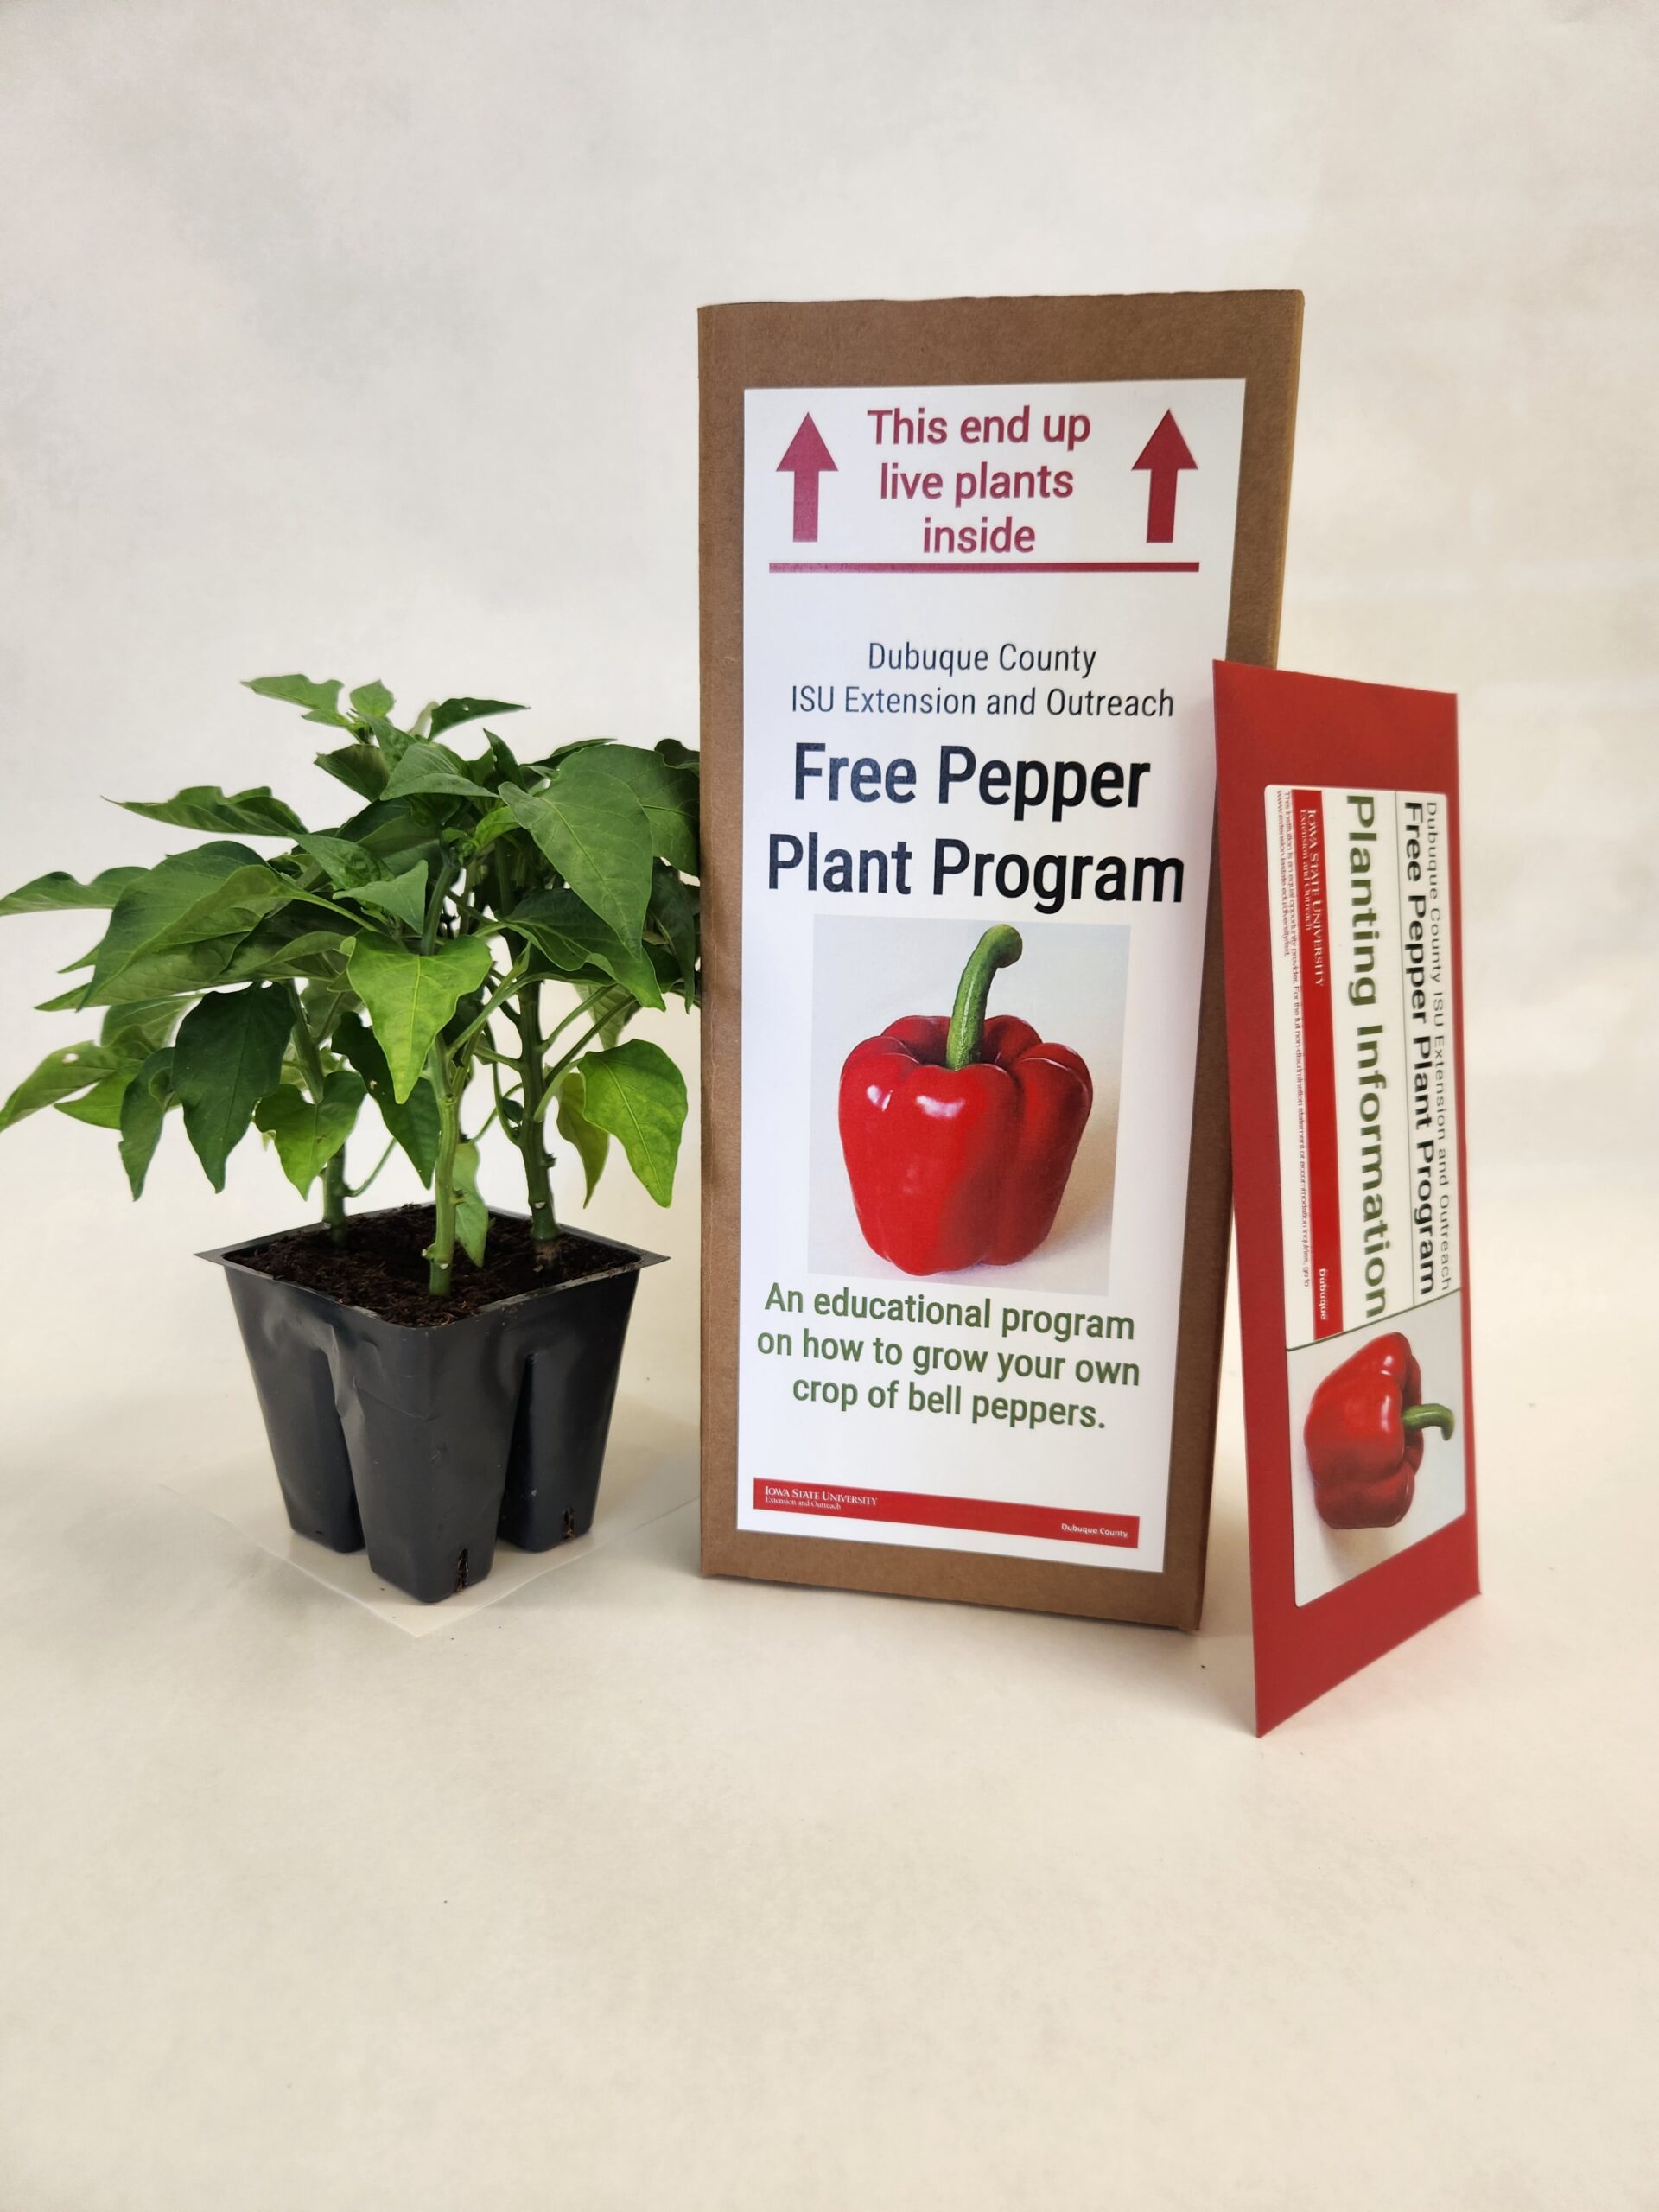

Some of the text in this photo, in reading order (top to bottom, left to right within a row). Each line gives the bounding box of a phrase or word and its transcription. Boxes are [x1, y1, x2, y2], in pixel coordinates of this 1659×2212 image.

[867, 405, 1091, 451] This end up
[880, 462, 1074, 508] live plants
[923, 517, 1036, 553] inside
[868, 642, 1097, 678] Dubuque County
[791, 686, 1174, 717] ISU Extension and Outreach
[794, 741, 1151, 823] Free Pepper
[768, 832, 1185, 915] Plant Program
[1306, 810, 1324, 986] IOWA STATE UNIVERSITY
[1288, 900, 1297, 947] opportunity
[1304, 883, 1313, 930] Outreach
[1346, 795, 1390, 1319] Planting Information
[1405, 802, 1434, 1294] Free Pepper Plant Program
[1427, 803, 1452, 1291] Dubuque County ISU Extension and Outreach
[765, 1282, 1135, 1344] An educational program
[1319, 1268, 1327, 1320] Dubuque
[757, 1328, 1141, 1387] on how to grow your own
[792, 1378, 1105, 1430] crop of bell peppers.
[765, 1496, 796, 1506] Extension
[810, 1500, 841, 1510] Outreach
[766, 1485, 878, 1506] IOWA STATE UNIVERSITY
[1061, 1523, 1128, 1537] Dubuque County
